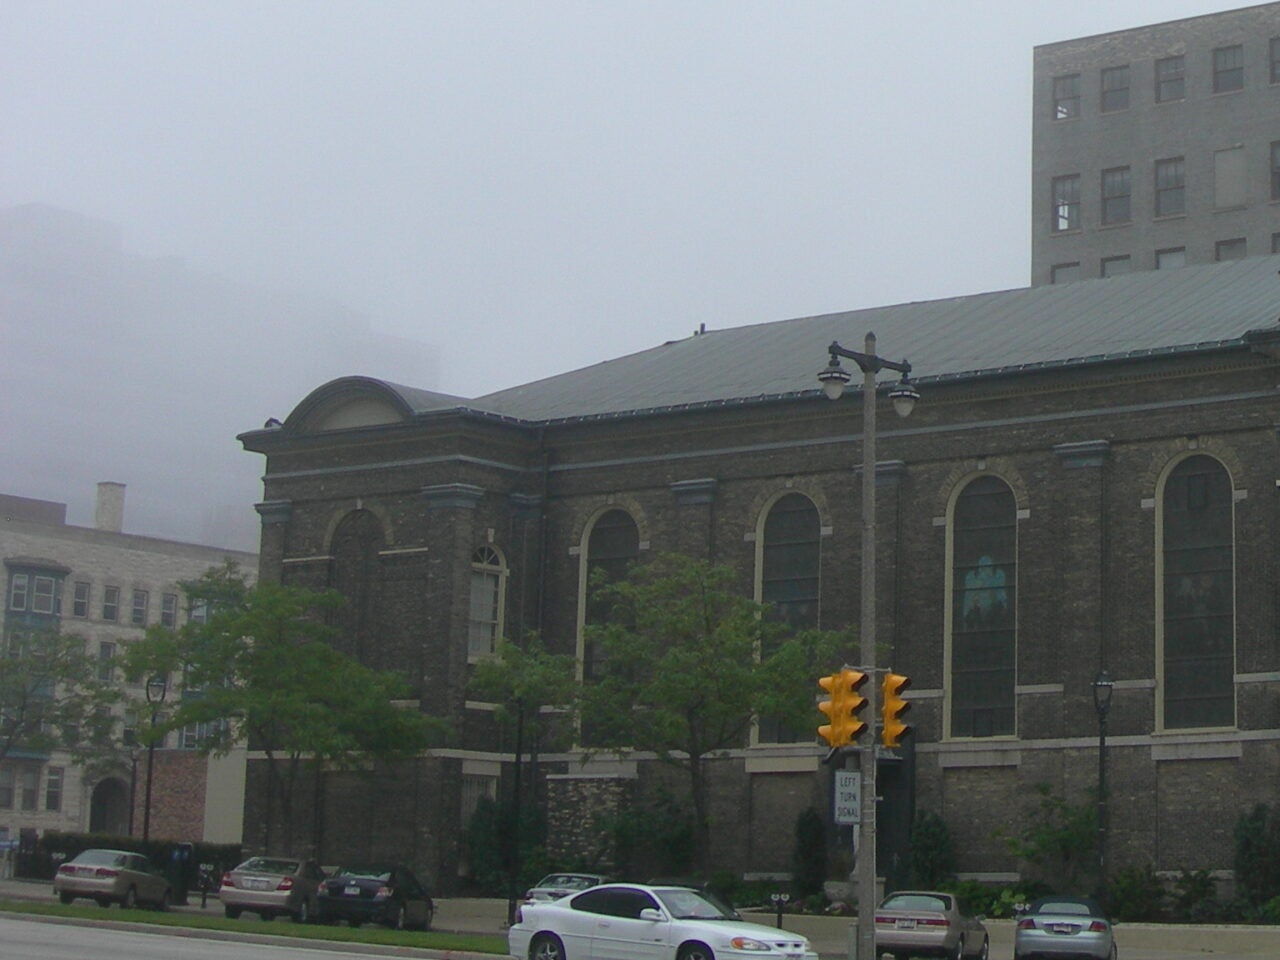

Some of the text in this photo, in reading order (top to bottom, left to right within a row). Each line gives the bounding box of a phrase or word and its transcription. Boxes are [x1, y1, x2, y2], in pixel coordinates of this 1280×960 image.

[840, 777, 856, 787] LEFT
[840, 792, 857, 802] TURN
[838, 806, 858, 817] SIGNAL
